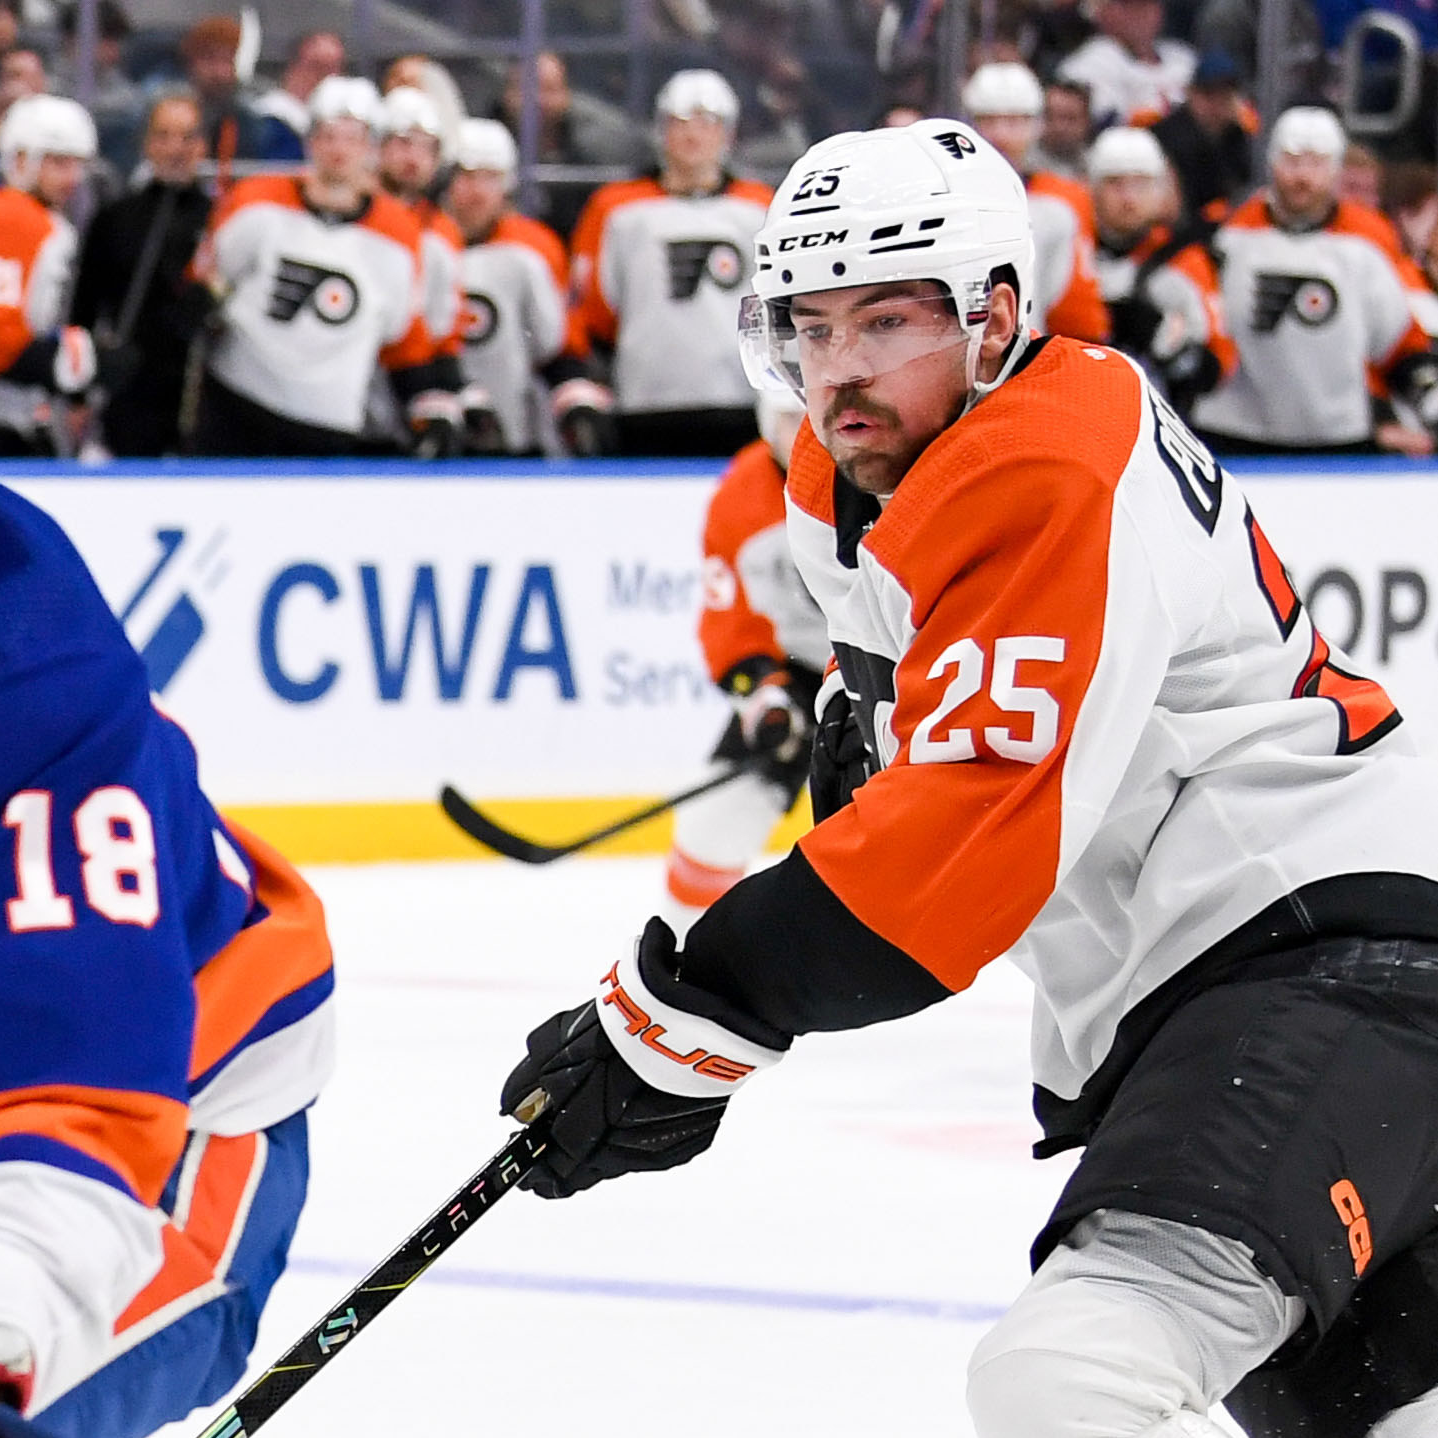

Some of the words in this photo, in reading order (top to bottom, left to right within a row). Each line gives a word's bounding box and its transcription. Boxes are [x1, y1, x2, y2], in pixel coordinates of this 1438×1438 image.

[777, 228, 850, 253] CCM
[791, 164, 851, 202] 25
[256, 560, 580, 704] CWA
[908, 634, 1066, 765] 25
[2, 784, 161, 933] 18
[599, 959, 758, 1083] TRUE
